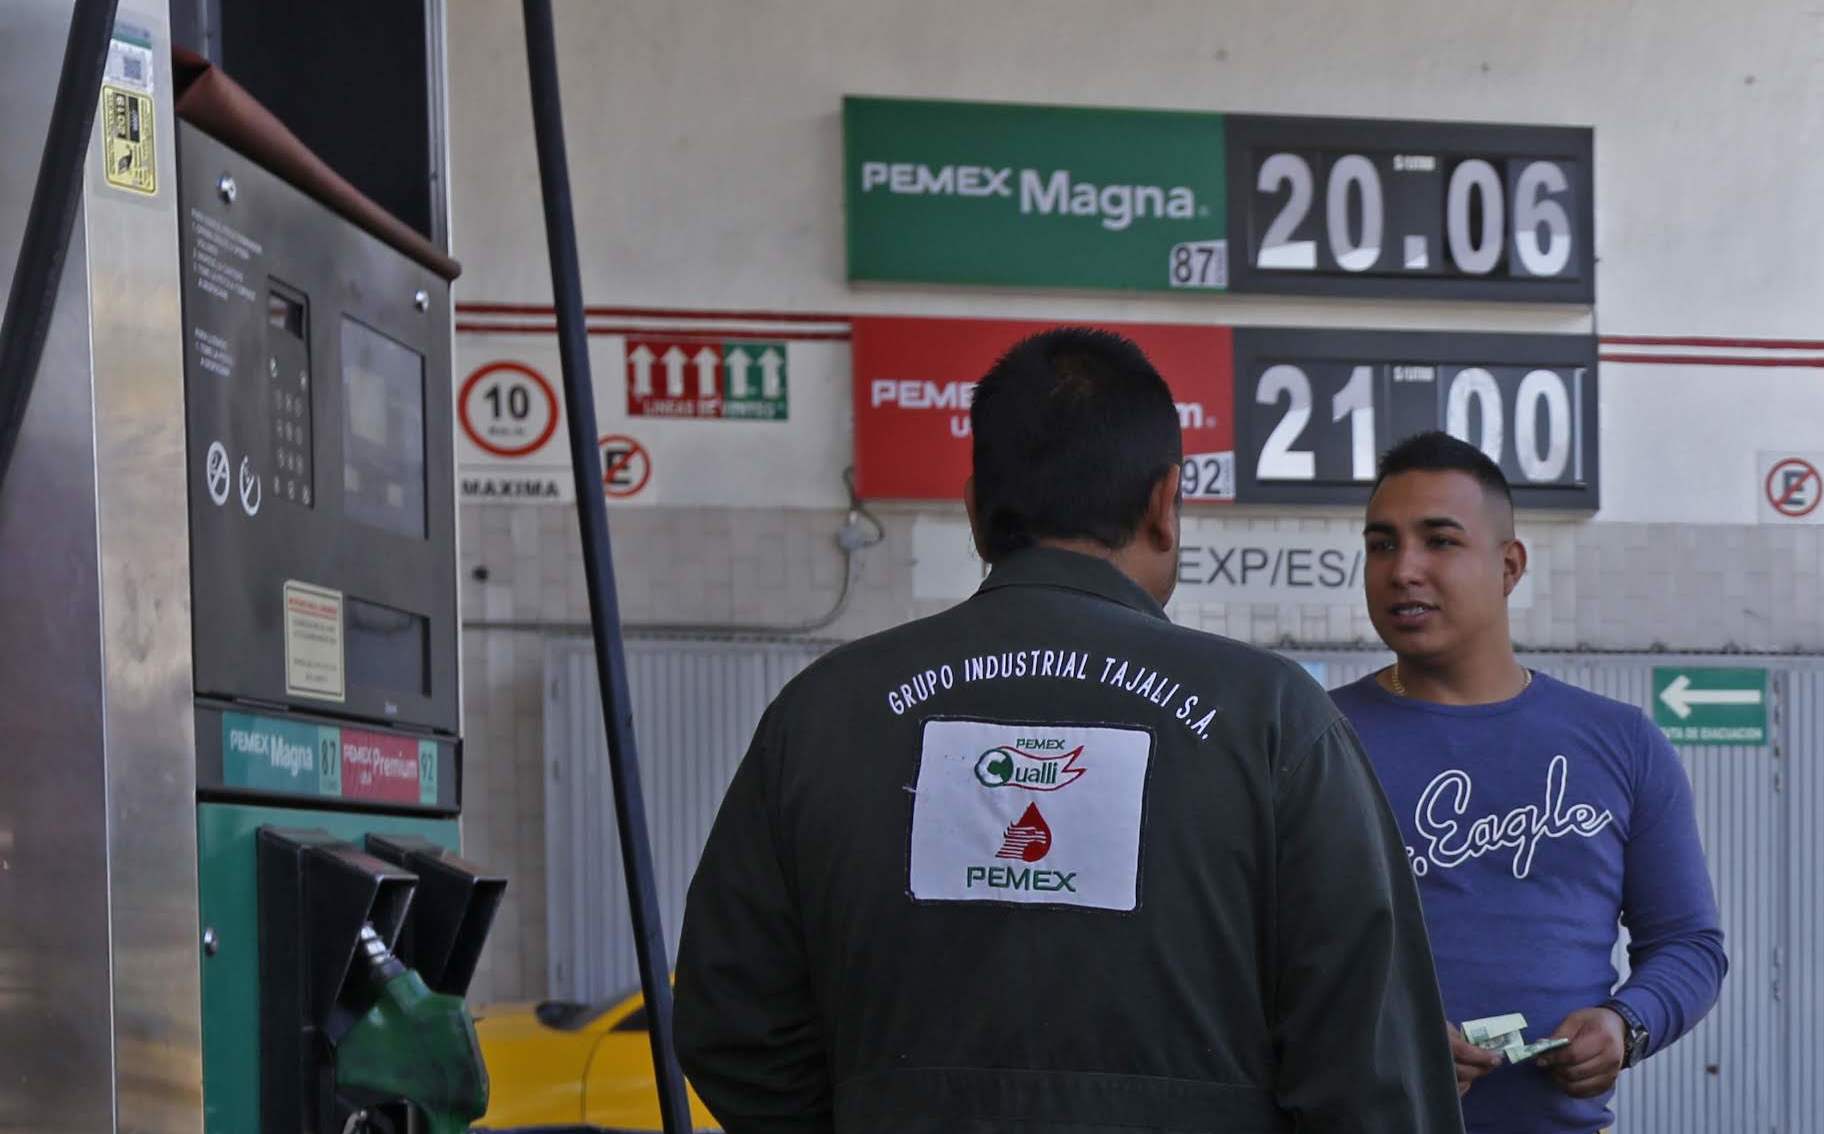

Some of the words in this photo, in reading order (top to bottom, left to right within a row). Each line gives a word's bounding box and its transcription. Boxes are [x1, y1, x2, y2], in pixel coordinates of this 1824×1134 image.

[862, 161, 1012, 197] PEMEX
[1019, 169, 1195, 230] Magna
[1257, 152, 1571, 277] 20.06
[1175, 246, 1214, 283] 87
[484, 385, 530, 420] 10
[870, 379, 979, 410] PEME
[1256, 364, 1570, 482] 2100
[606, 450, 632, 485] E
[1182, 458, 1221, 495] 92
[462, 478, 559, 498] MAXIMA
[1782, 469, 1807, 507] E
[1177, 546, 1362, 588] EXP/ES/
[888, 664, 954, 716] GRUPO
[964, 649, 1090, 682] INDUSTRIAL
[1099, 656, 1180, 709] TAJALI
[1175, 694, 1218, 742] S.A.
[230, 729, 268, 756] PEMEX
[270, 734, 314, 776] Magna
[321, 739, 336, 775] 87
[1015, 737, 1067, 751] PEMEX
[373, 747, 418, 779] Premium
[420, 752, 434, 783] 92
[1414, 754, 1614, 879] Eagle
[967, 865, 1078, 893] PEMEX
